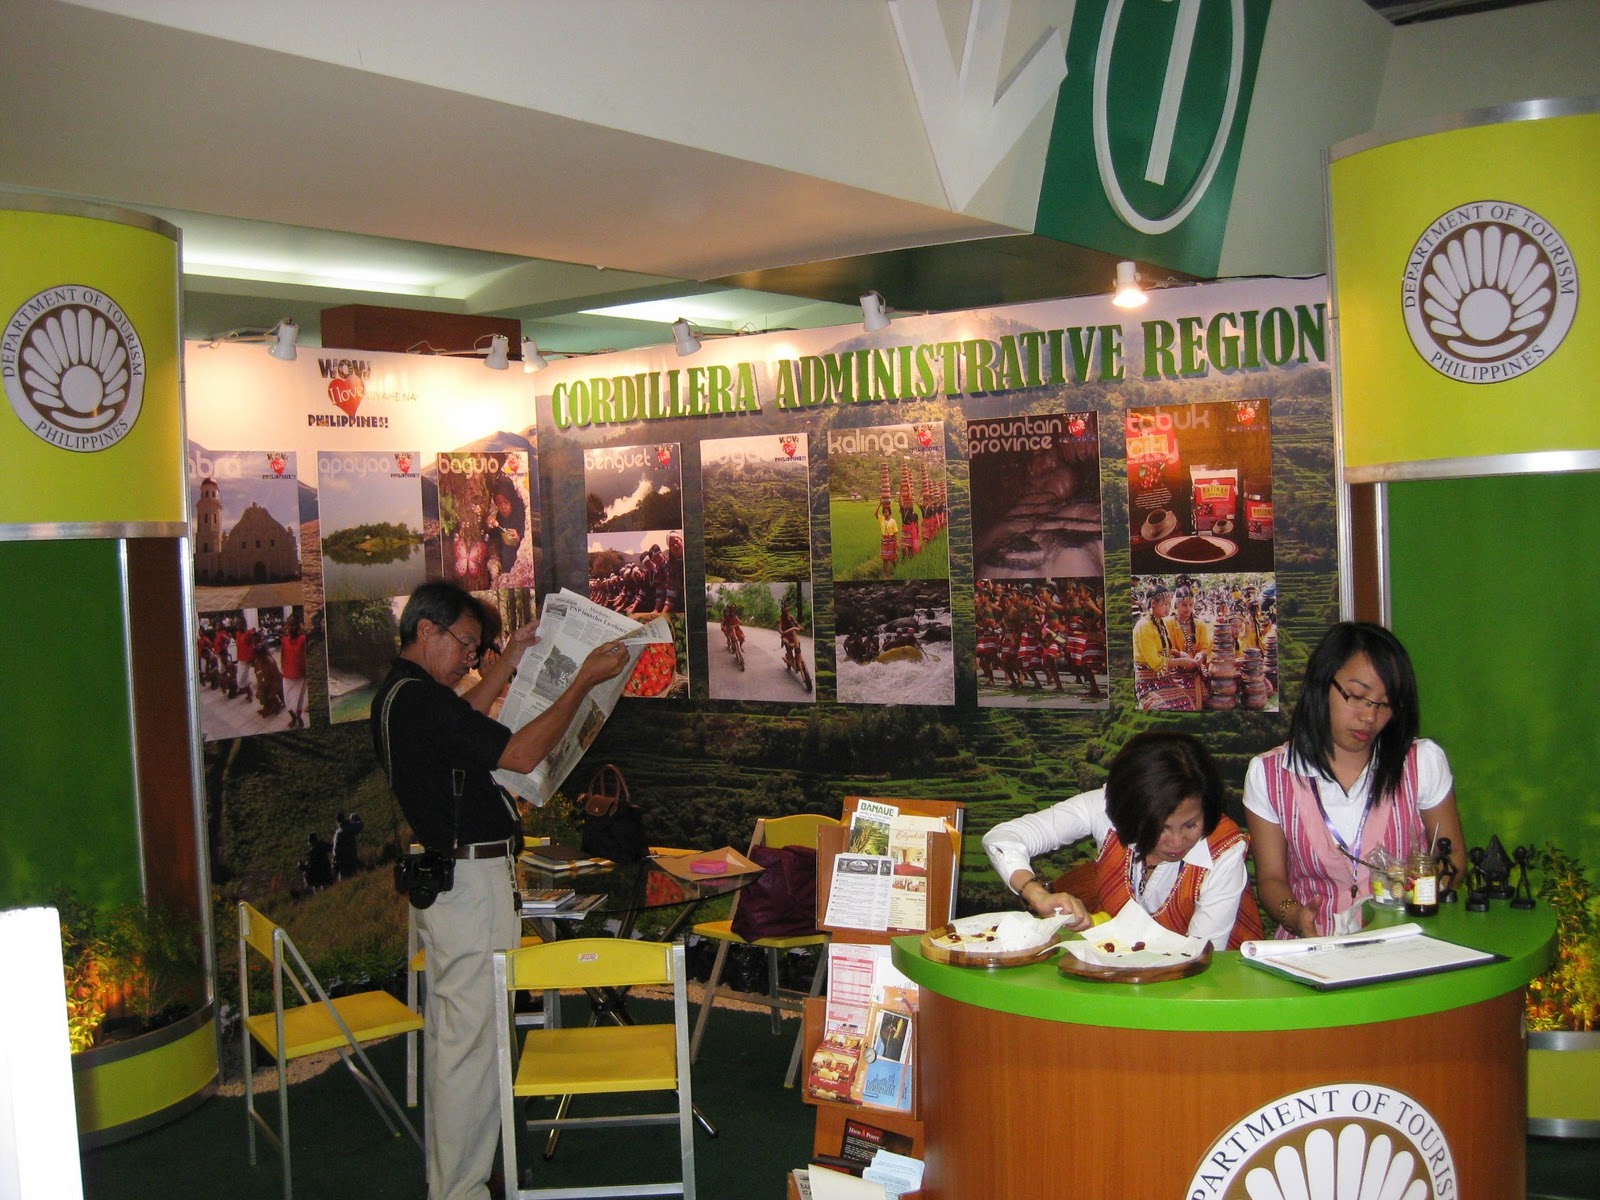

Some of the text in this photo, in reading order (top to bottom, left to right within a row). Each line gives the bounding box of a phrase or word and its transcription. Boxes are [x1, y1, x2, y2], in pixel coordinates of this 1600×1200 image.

[1405, 205, 1574, 308] DEPARTMENT OF TOURISM
[3, 288, 143, 378] DEPARTMENT OF TOURISM
[318, 358, 371, 380] WOW
[552, 303, 1327, 429] CORDILLERA ADMINISTRATIVE REGION
[1430, 344, 1545, 380] PHILIPPINES
[36, 418, 129, 449] PHILIPPINES
[967, 416, 1062, 439] mountain
[827, 429, 909, 457] kalinga
[967, 435, 1053, 459] province
[319, 457, 390, 480] apayao
[439, 453, 499, 480] baguio
[584, 448, 652, 474] benguet
[860, 802, 895, 817] BANAUE
[1351, 1089, 1391, 1115] OF
[1395, 1100, 1455, 1200] TOURIS
